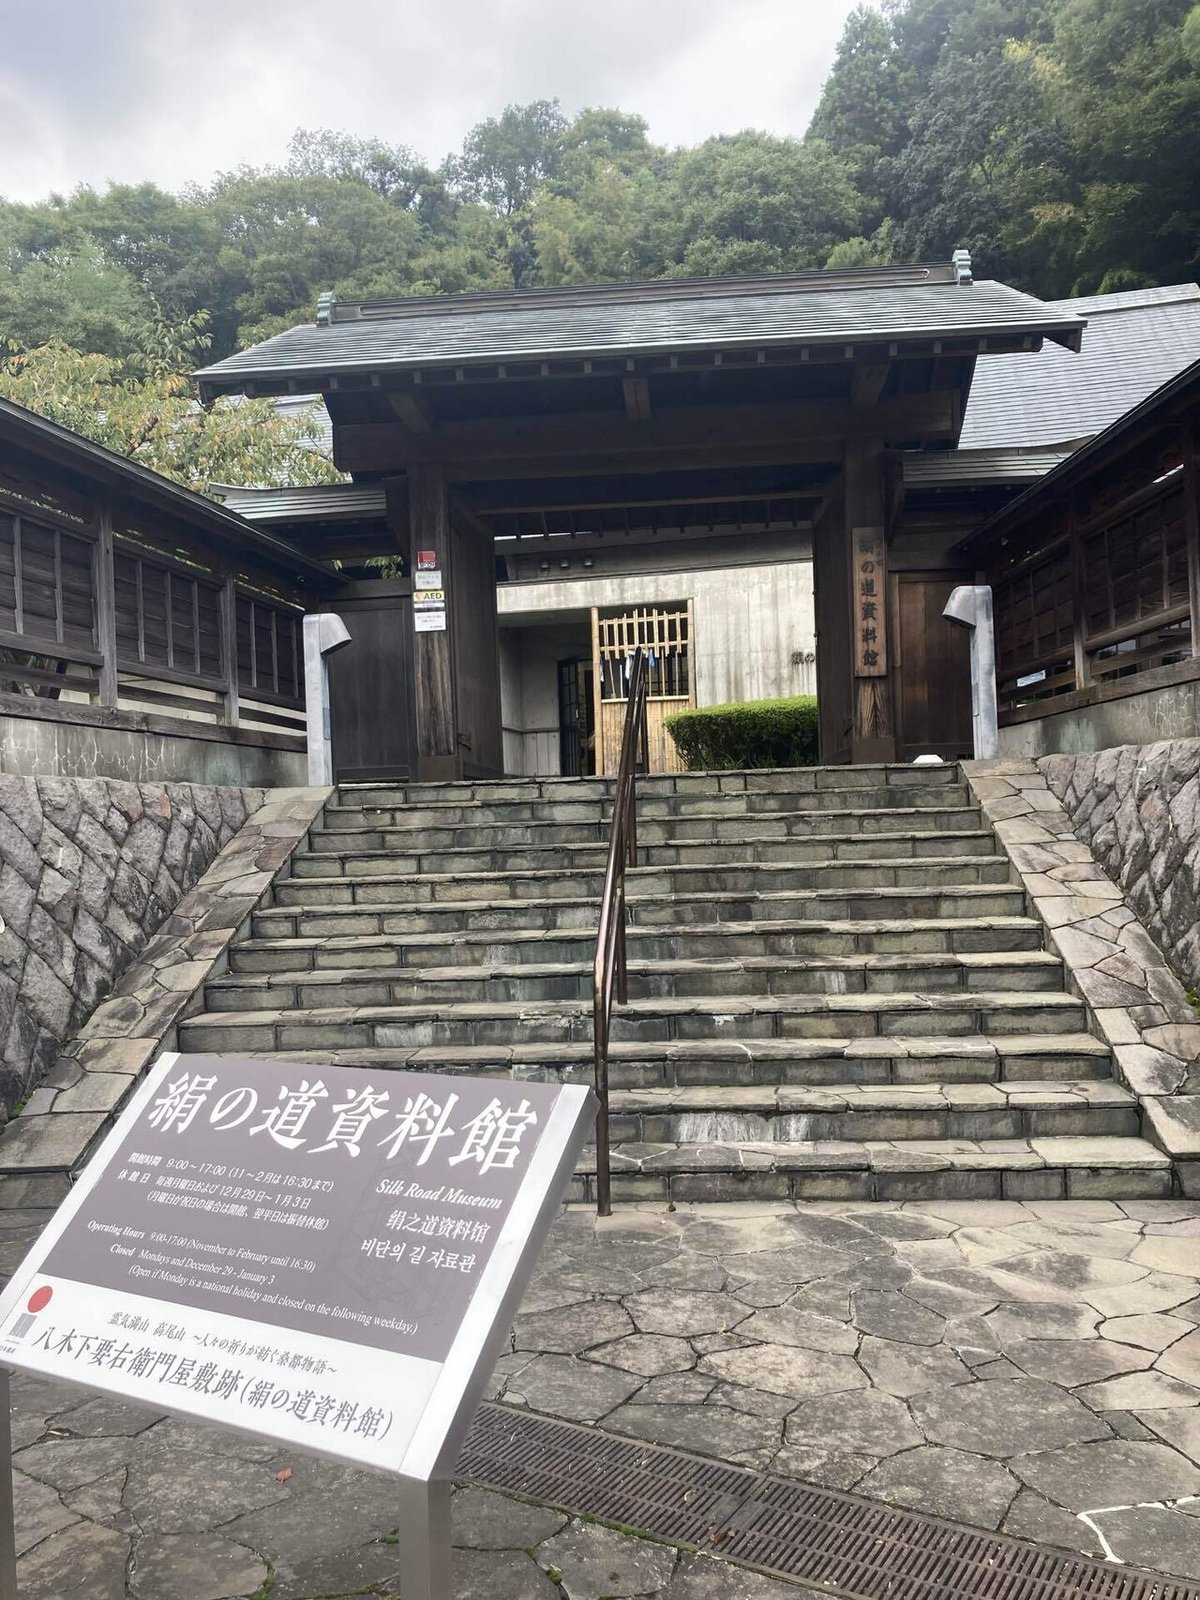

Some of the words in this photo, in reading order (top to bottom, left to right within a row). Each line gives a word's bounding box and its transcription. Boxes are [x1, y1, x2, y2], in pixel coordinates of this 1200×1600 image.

[423, 592, 442, 600] AED
[148, 1071, 538, 1175] 絹の道資料館
[128, 1152, 162, 1166] 開館時間
[376, 1178, 404, 1195] Silk
[404, 1182, 446, 1201] Road
[441, 1187, 503, 1209] Museum
[87, 1220, 123, 1237] Operating
[122, 1226, 146, 1239] Hours
[186, 1239, 227, 1255] (November
[227, 1248, 236, 1257] to
[236, 1248, 271, 1265] February
[270, 1256, 290, 1268] until
[290, 1258, 316, 1273] 16:30)
[110, 1243, 136, 1257] Closed
[138, 1249, 171, 1265] Mondays
[170, 1256, 186, 1267] and
[184, 1258, 222, 1275] December
[222, 1265, 233, 1276] 29
[237, 1268, 269, 1285] January
[268, 1274, 276, 1285] 3
[361, 1237, 406, 1262] 비단의
[409, 1245, 427, 1265] 길
[427, 1248, 476, 1273] 자료관
[128, 1264, 151, 1278] (Open
[151, 1268, 161, 1279] if
[159, 1270, 188, 1287] Monday
[188, 1276, 196, 1287] is
[202, 1280, 233, 1294] national
[232, 1284, 262, 1302] holiday
[262, 1293, 279, 1304] and
[277, 1296, 305, 1309] closed
[305, 1302, 315, 1312] on
[317, 1303, 331, 1315] the
[331, 1305, 372, 1327] following
[374, 1317, 418, 1336] weekday.)
[153, 1321, 186, 1341] 高尾山
